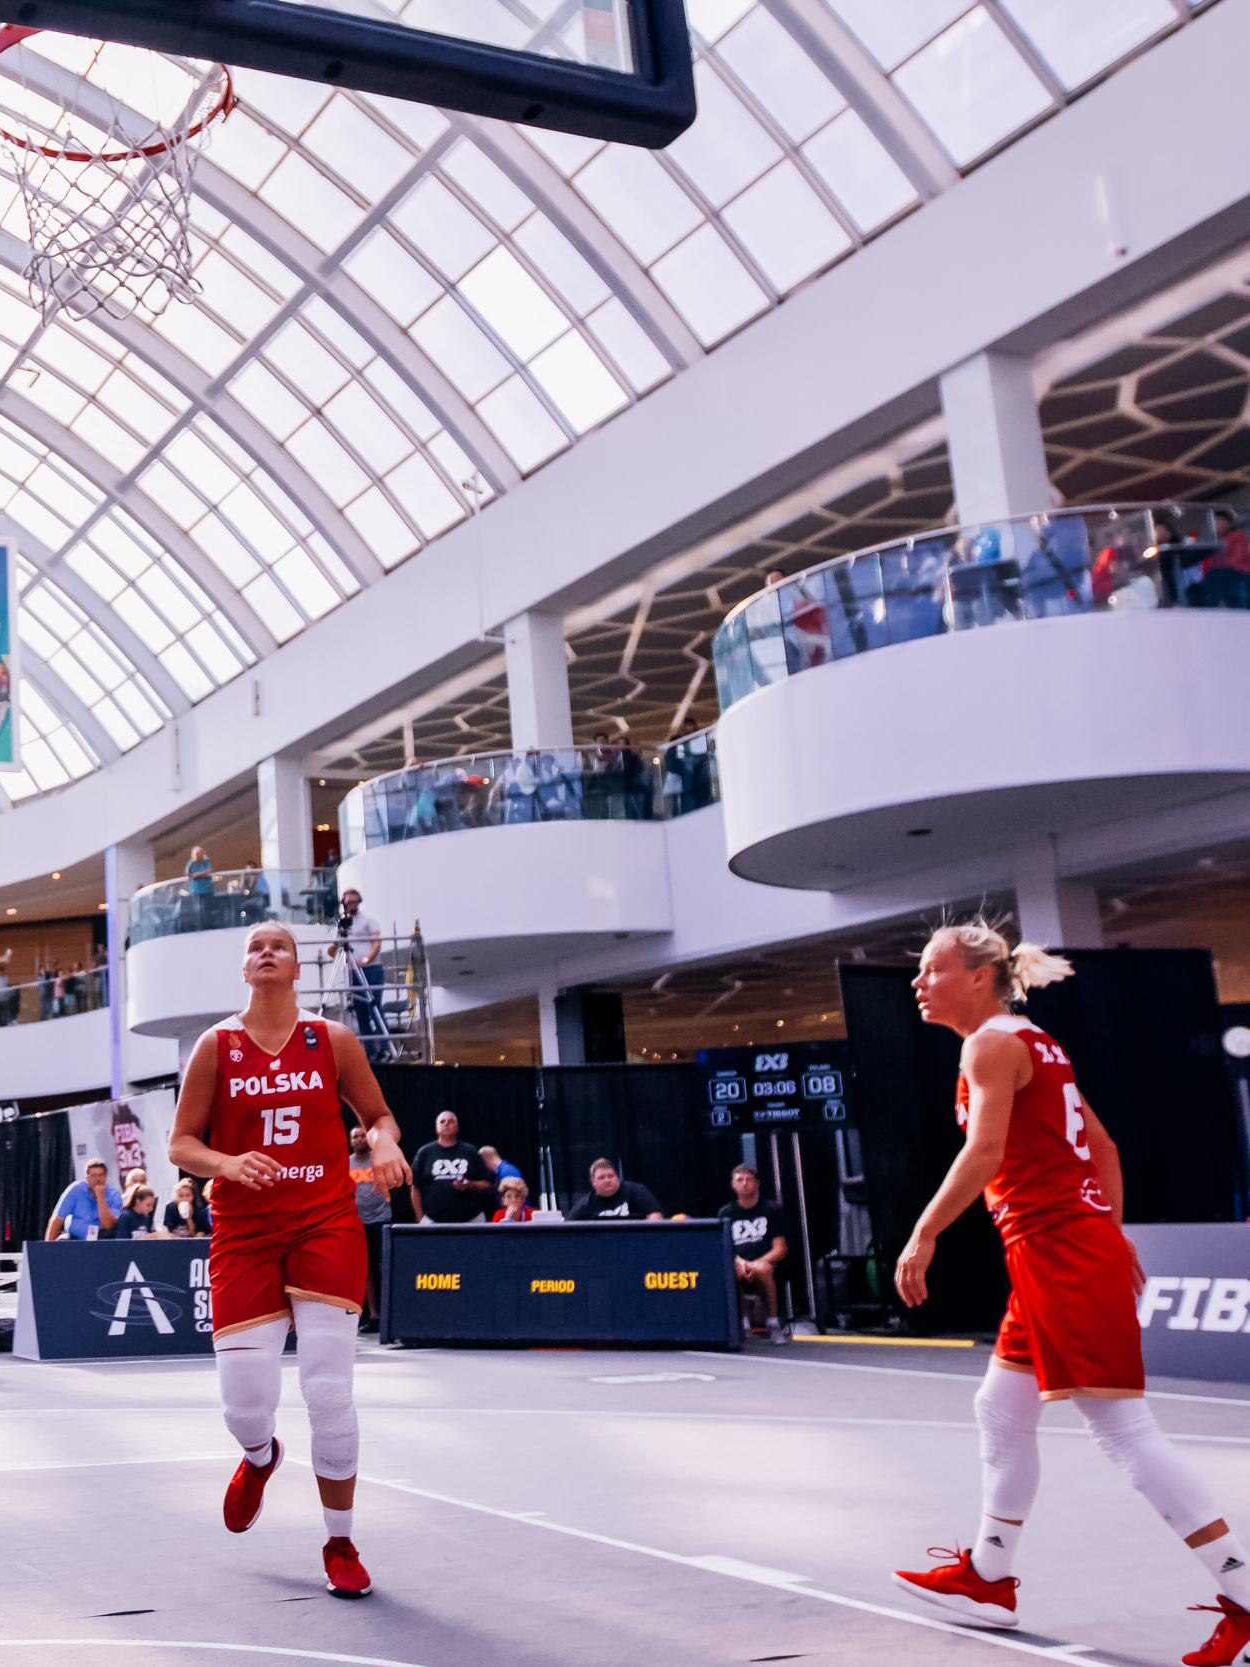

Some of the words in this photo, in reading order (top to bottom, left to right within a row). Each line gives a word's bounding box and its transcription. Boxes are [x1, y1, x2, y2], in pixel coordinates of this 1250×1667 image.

[229, 1070, 324, 1098] POLSKA
[715, 1082, 740, 1100] 20
[753, 1080, 797, 1097] 03:06
[808, 1075, 836, 1094] 08
[831, 1107, 839, 1117] 7
[260, 1105, 302, 1147] 15
[277, 1164, 324, 1183] nerga
[416, 1274, 461, 1290] HOME
[530, 1280, 575, 1293] PERIOD
[645, 1271, 699, 1290] GUEST
[1136, 1275, 1250, 1334] FIB
